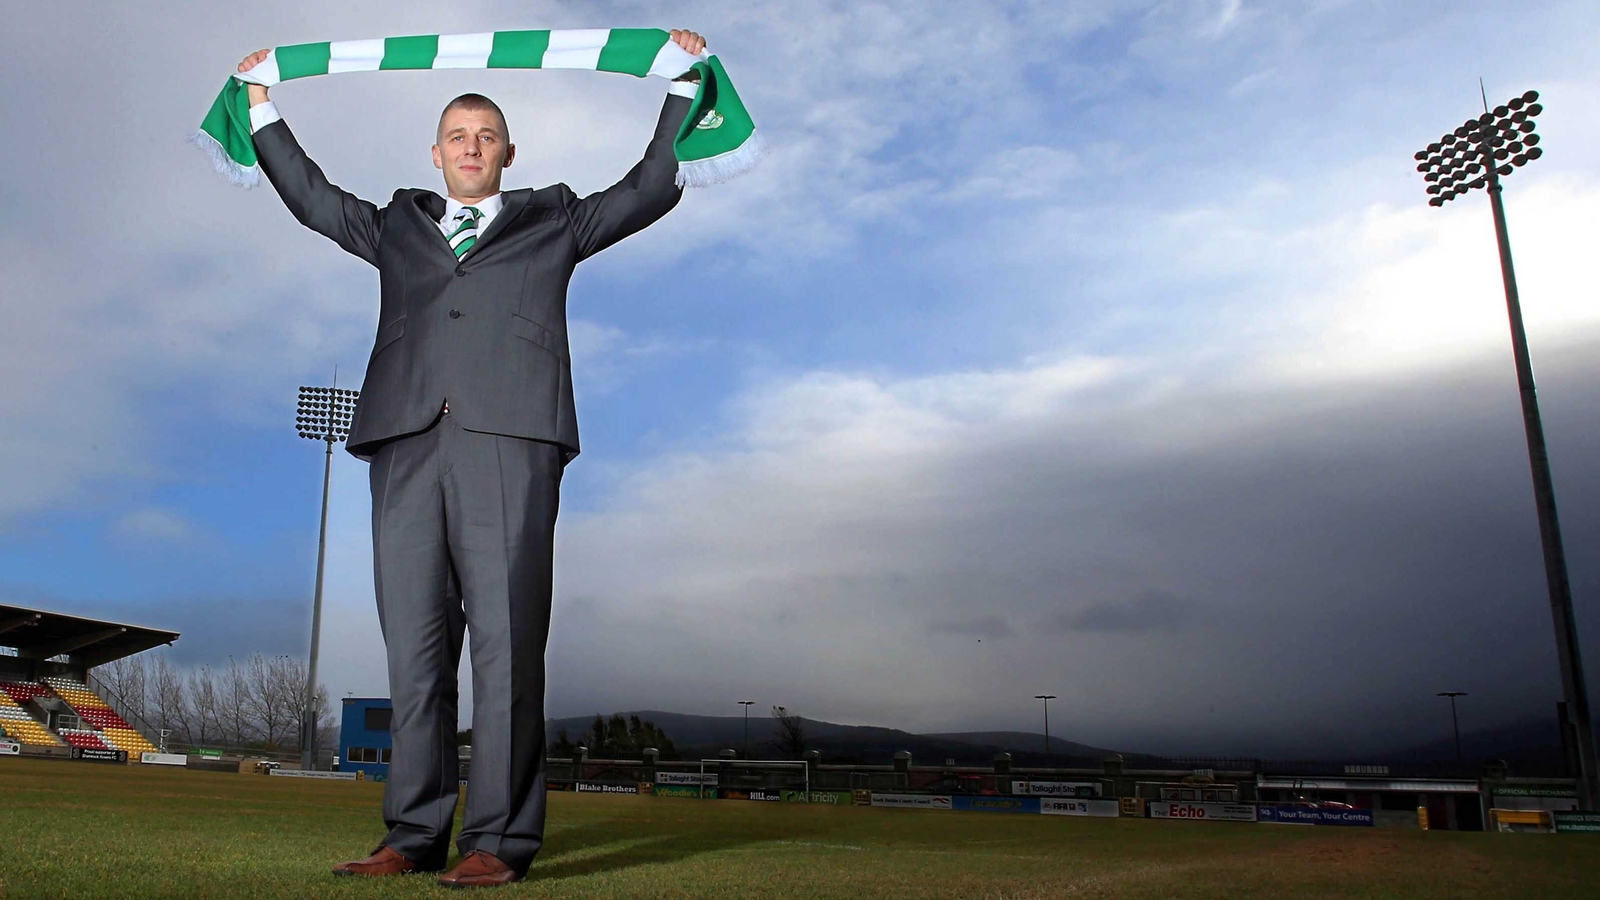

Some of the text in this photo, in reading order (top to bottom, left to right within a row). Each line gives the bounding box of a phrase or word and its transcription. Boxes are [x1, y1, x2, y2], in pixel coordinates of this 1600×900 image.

[73, 748, 80, 759] 3
[118, 751, 126, 762] 3
[669, 775, 690, 783] Tallaght
[580, 784, 636, 793] Blake Brothers
[656, 788, 697, 797] Woodie's
[1031, 785, 1061, 794] Tallaght
[1498, 788, 1528, 796] OFFICIAL
[1053, 803, 1068, 811] FIFA
[1169, 804, 1205, 818] Echo
[1278, 810, 1371, 822] Your Team, Your Centre
